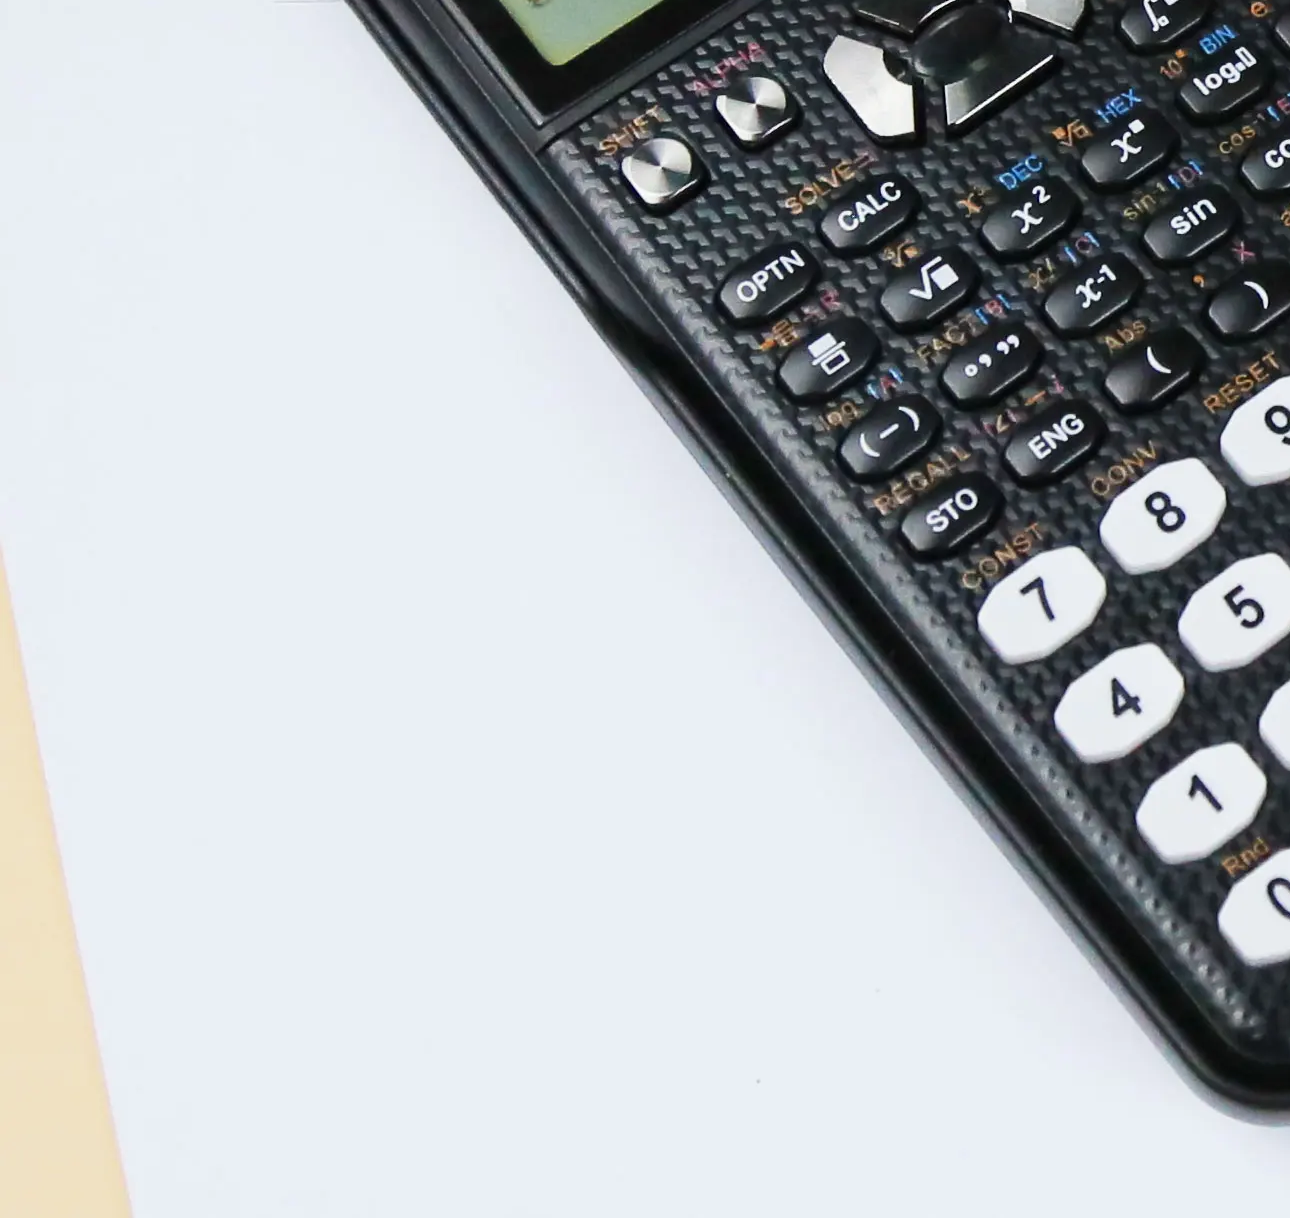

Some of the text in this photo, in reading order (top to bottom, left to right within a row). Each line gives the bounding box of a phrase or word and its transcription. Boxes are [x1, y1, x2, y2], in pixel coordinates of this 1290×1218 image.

[1199, 24, 1236, 56] BIN
[1096, 88, 1142, 124] HEX
[598, 105, 667, 158] SHIFT
[784, 158, 857, 215] SOLVE
[999, 154, 1044, 191] DEC
[837, 181, 902, 231] CALC
[1170, 198, 1217, 235] sin
[736, 249, 805, 302] OPTN
[1104, 319, 1146, 353] Abs
[1203, 350, 1282, 415] RESET
[1028, 413, 1085, 459] ENG
[872, 445, 971, 516] RECALL
[1091, 440, 1158, 496] CONV
[926, 488, 978, 533] STO
[1144, 491, 1186, 533] 8
[961, 522, 1043, 592] CONST
[1020, 577, 1055, 621] 7
[1223, 585, 1265, 629] 5
[1110, 677, 1142, 717] 4
[1188, 774, 1223, 813] 1
[1221, 836, 1270, 878] Rnd
